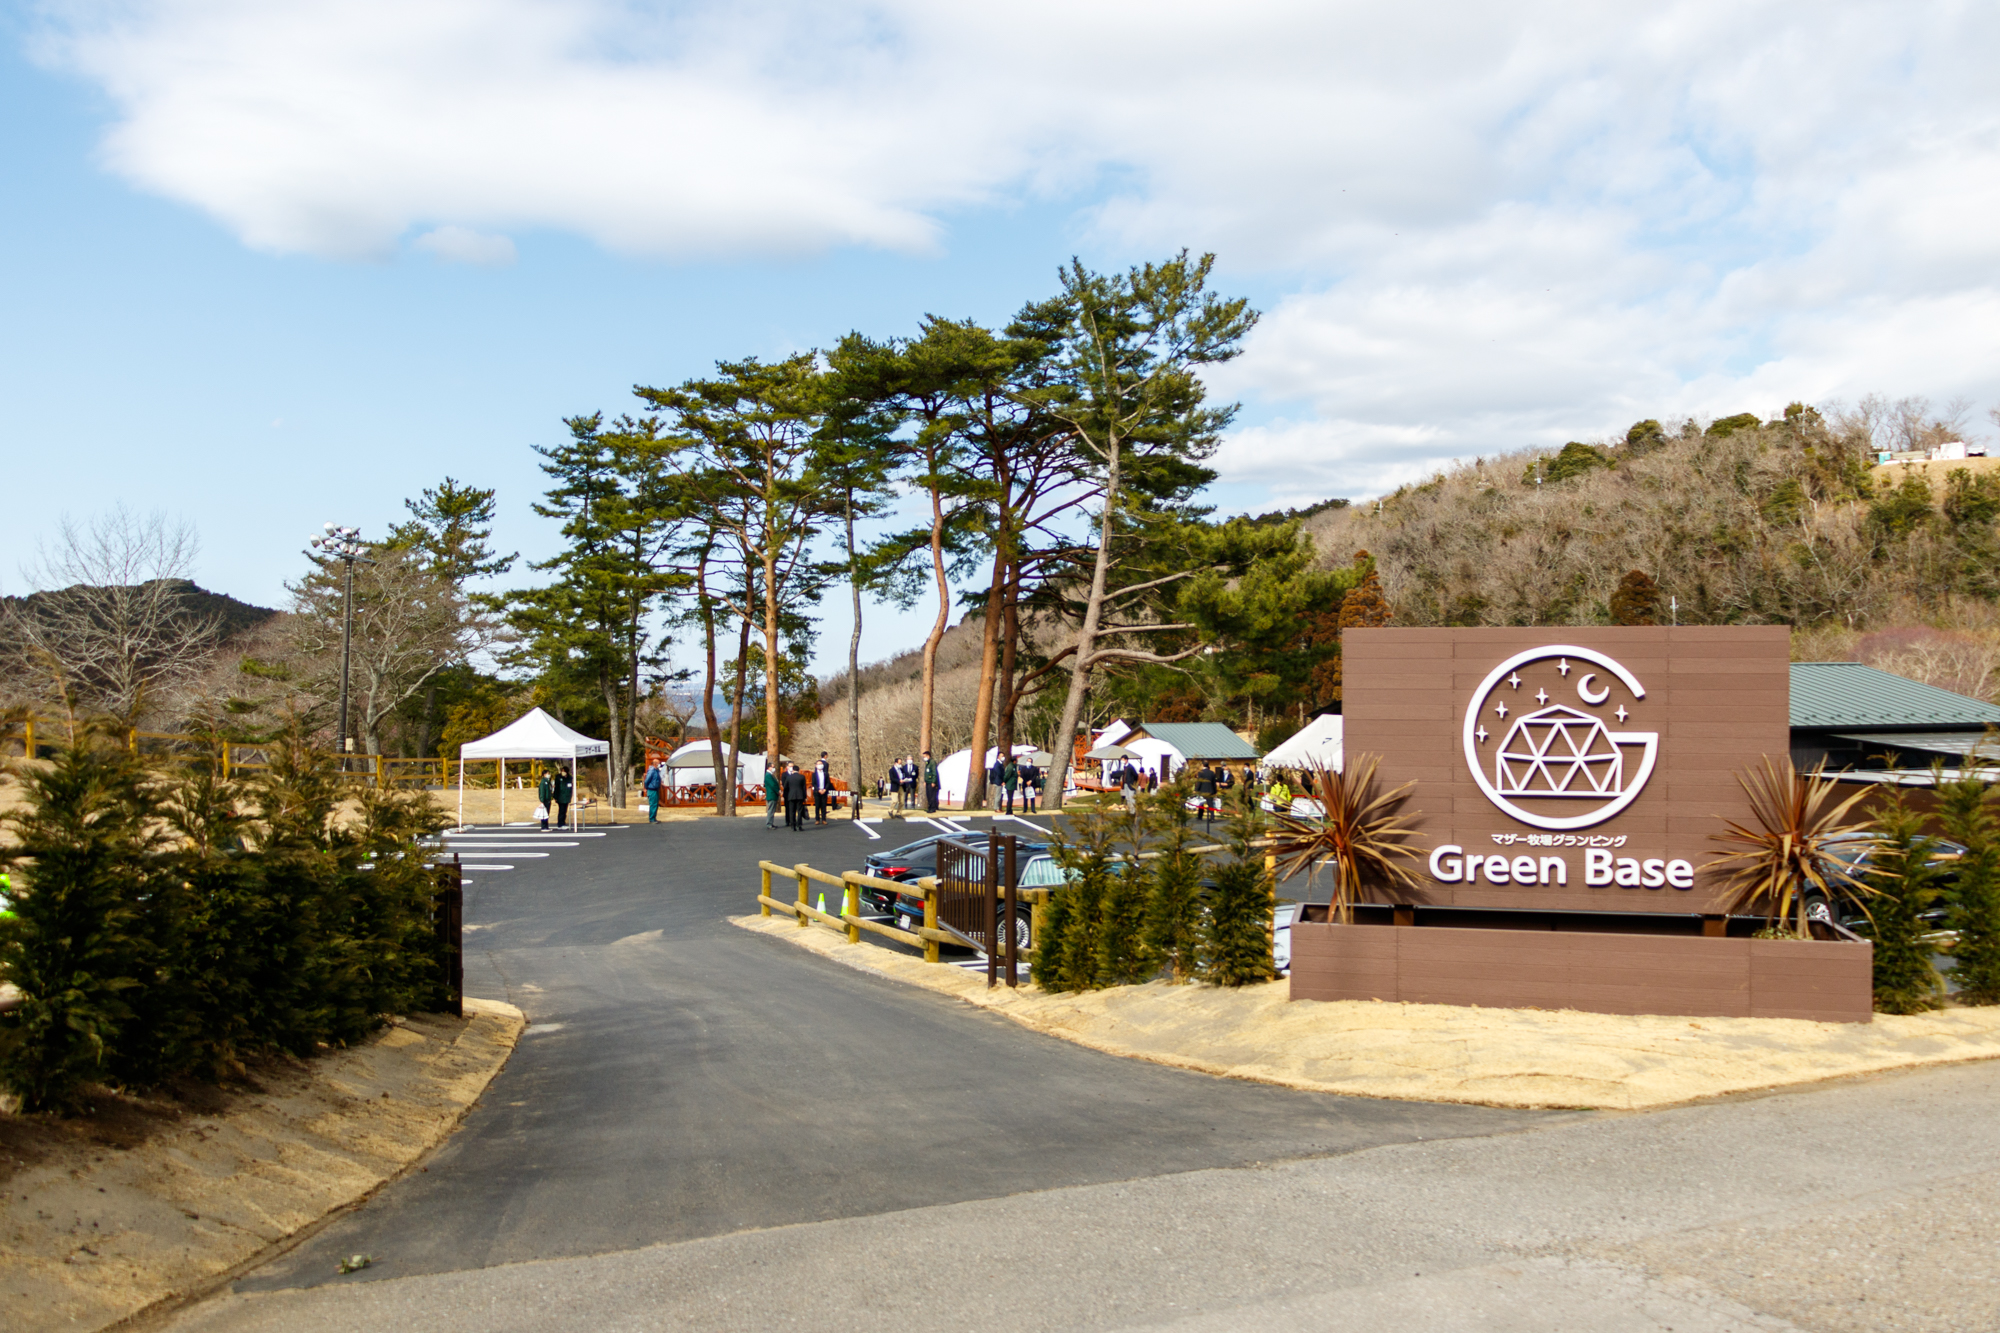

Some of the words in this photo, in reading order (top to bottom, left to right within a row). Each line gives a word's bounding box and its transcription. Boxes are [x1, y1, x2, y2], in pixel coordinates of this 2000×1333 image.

[1491, 833, 1627, 848] マザー牧場グランピング
[1429, 845, 1567, 884] Green
[1585, 847, 1694, 888] Base
